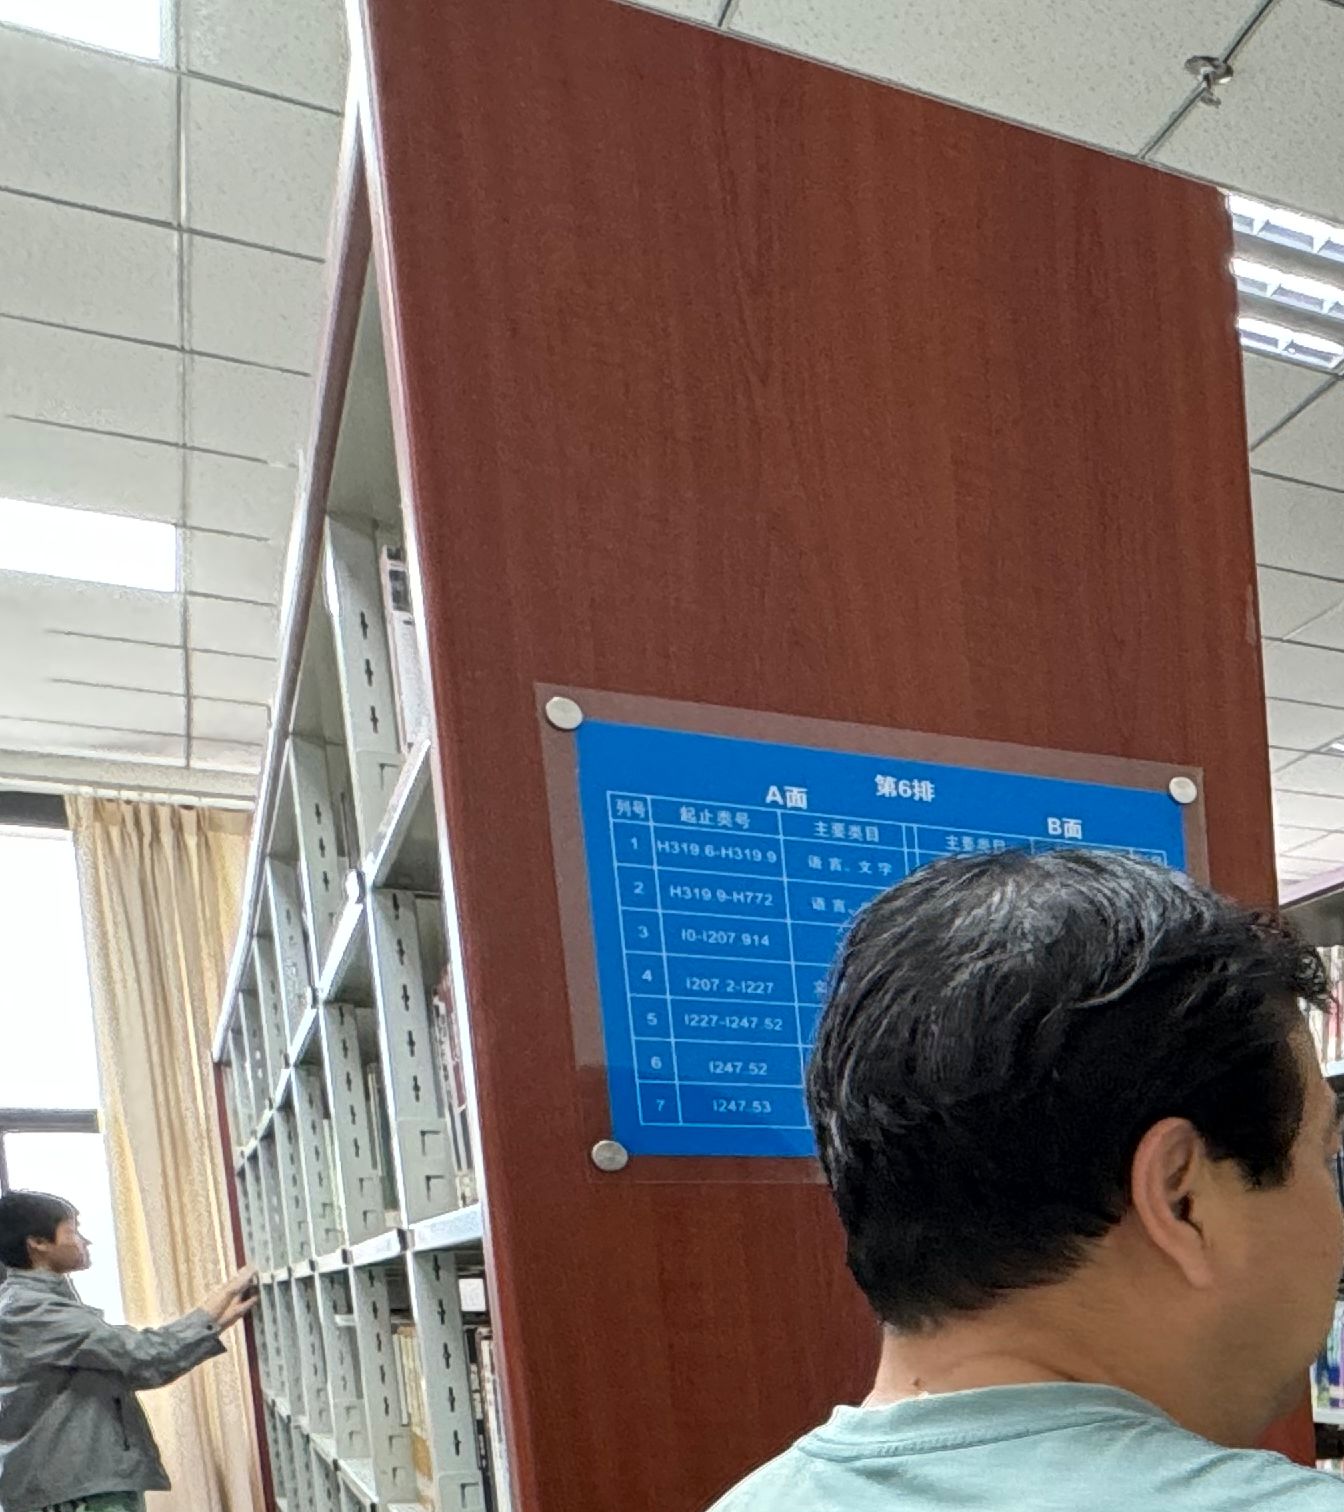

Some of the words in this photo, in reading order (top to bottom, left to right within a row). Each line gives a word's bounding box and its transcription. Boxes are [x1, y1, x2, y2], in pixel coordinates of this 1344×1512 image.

[874, 774, 936, 802] 第6排
[764, 785, 808, 811] A面
[813, 820, 881, 843] 主要类目
[1046, 817, 1083, 840] B面
[630, 837, 639, 850] 1
[633, 881, 644, 895] 2
[638, 925, 649, 939] 3
[641, 968, 653, 983] 4
[646, 1011, 658, 1026] 5
[649, 1055, 662, 1070] 6
[655, 1099, 666, 1112] 7
